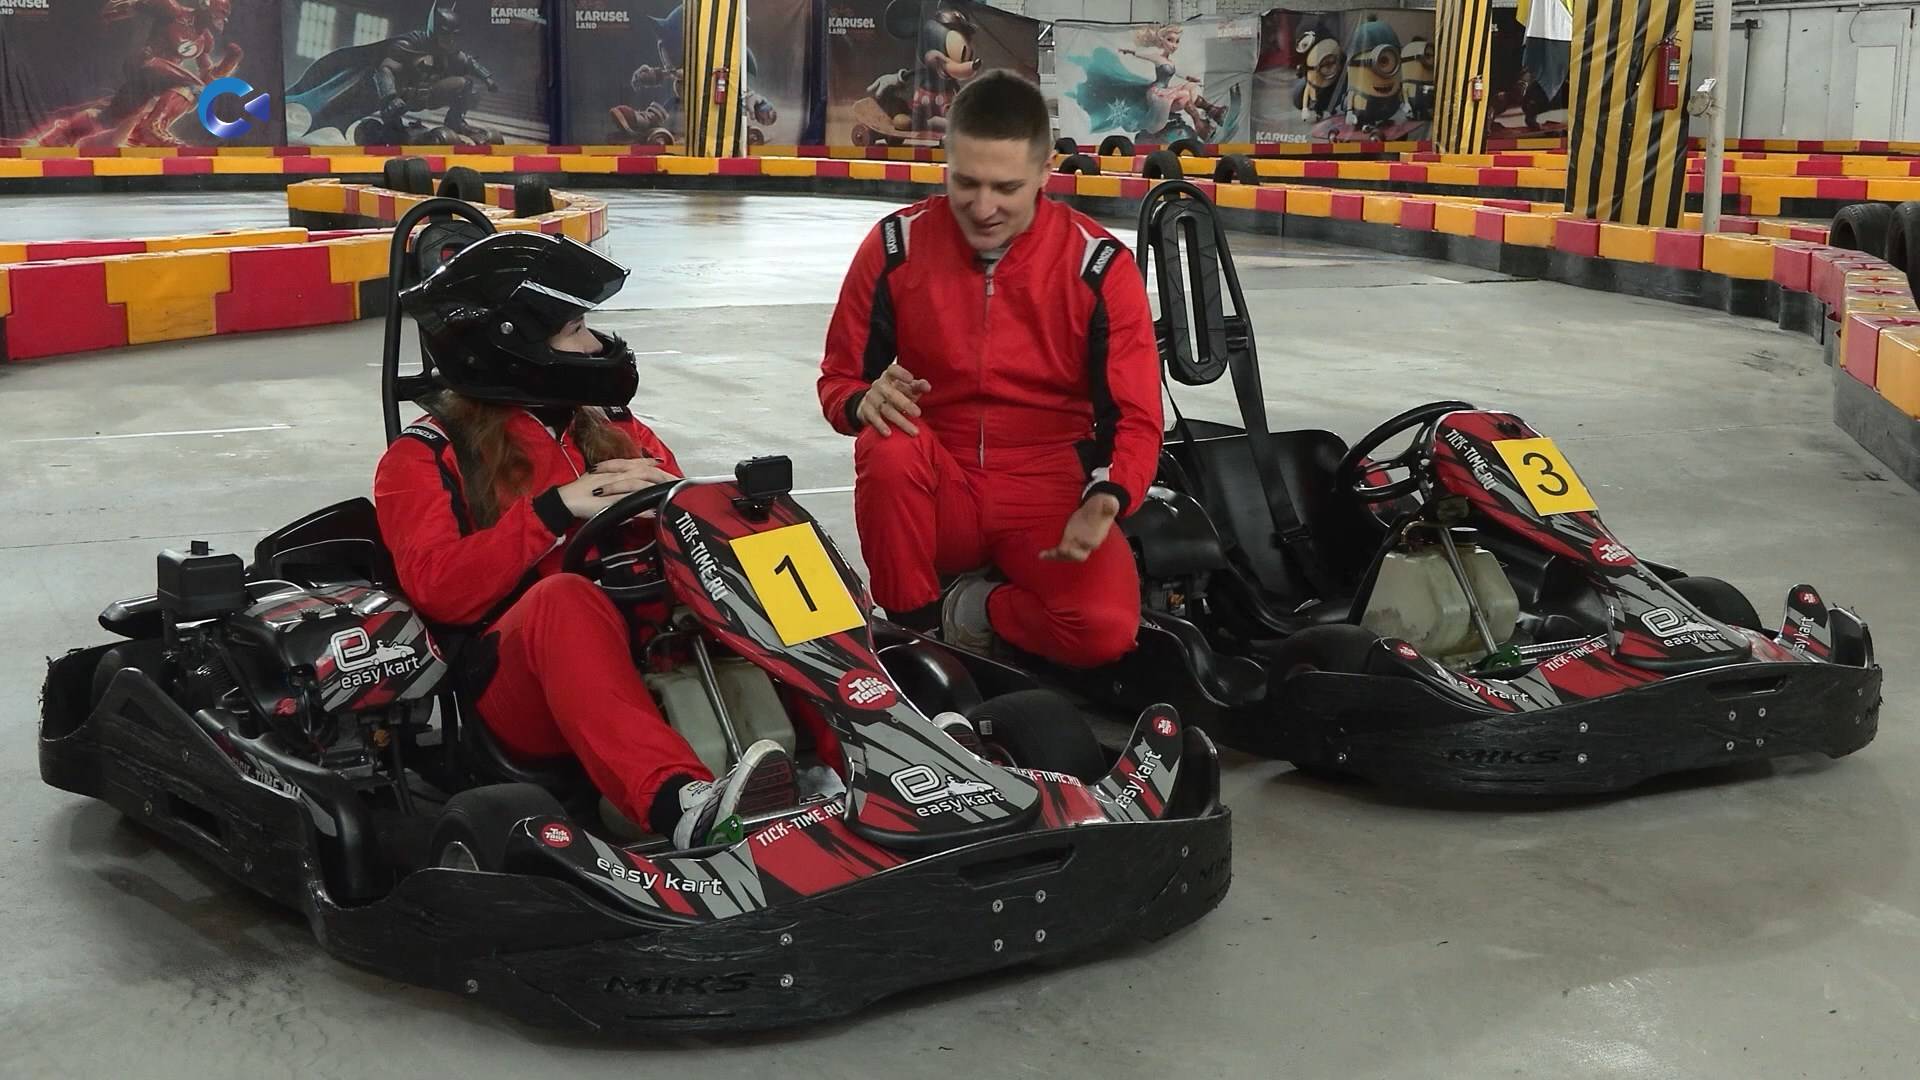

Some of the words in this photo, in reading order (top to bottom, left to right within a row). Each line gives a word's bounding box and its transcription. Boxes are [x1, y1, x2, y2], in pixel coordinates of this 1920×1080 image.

[1445, 429, 1497, 490] TICK-TIME.RU
[1523, 452, 1568, 496] 3
[675, 512, 730, 601] TICK-TIME.RU
[774, 555, 818, 612] 1
[1545, 640, 1608, 671] TICK-TIME.RU
[1663, 633, 1698, 647] easy
[341, 668, 381, 689] easy
[384, 656, 420, 677] kart
[1128, 750, 1162, 783] kart
[916, 798, 963, 817] easy
[965, 789, 1004, 807] kart
[755, 801, 846, 847] TICK-TIME.RU
[596, 857, 658, 889] easy
[665, 872, 722, 895] kart
